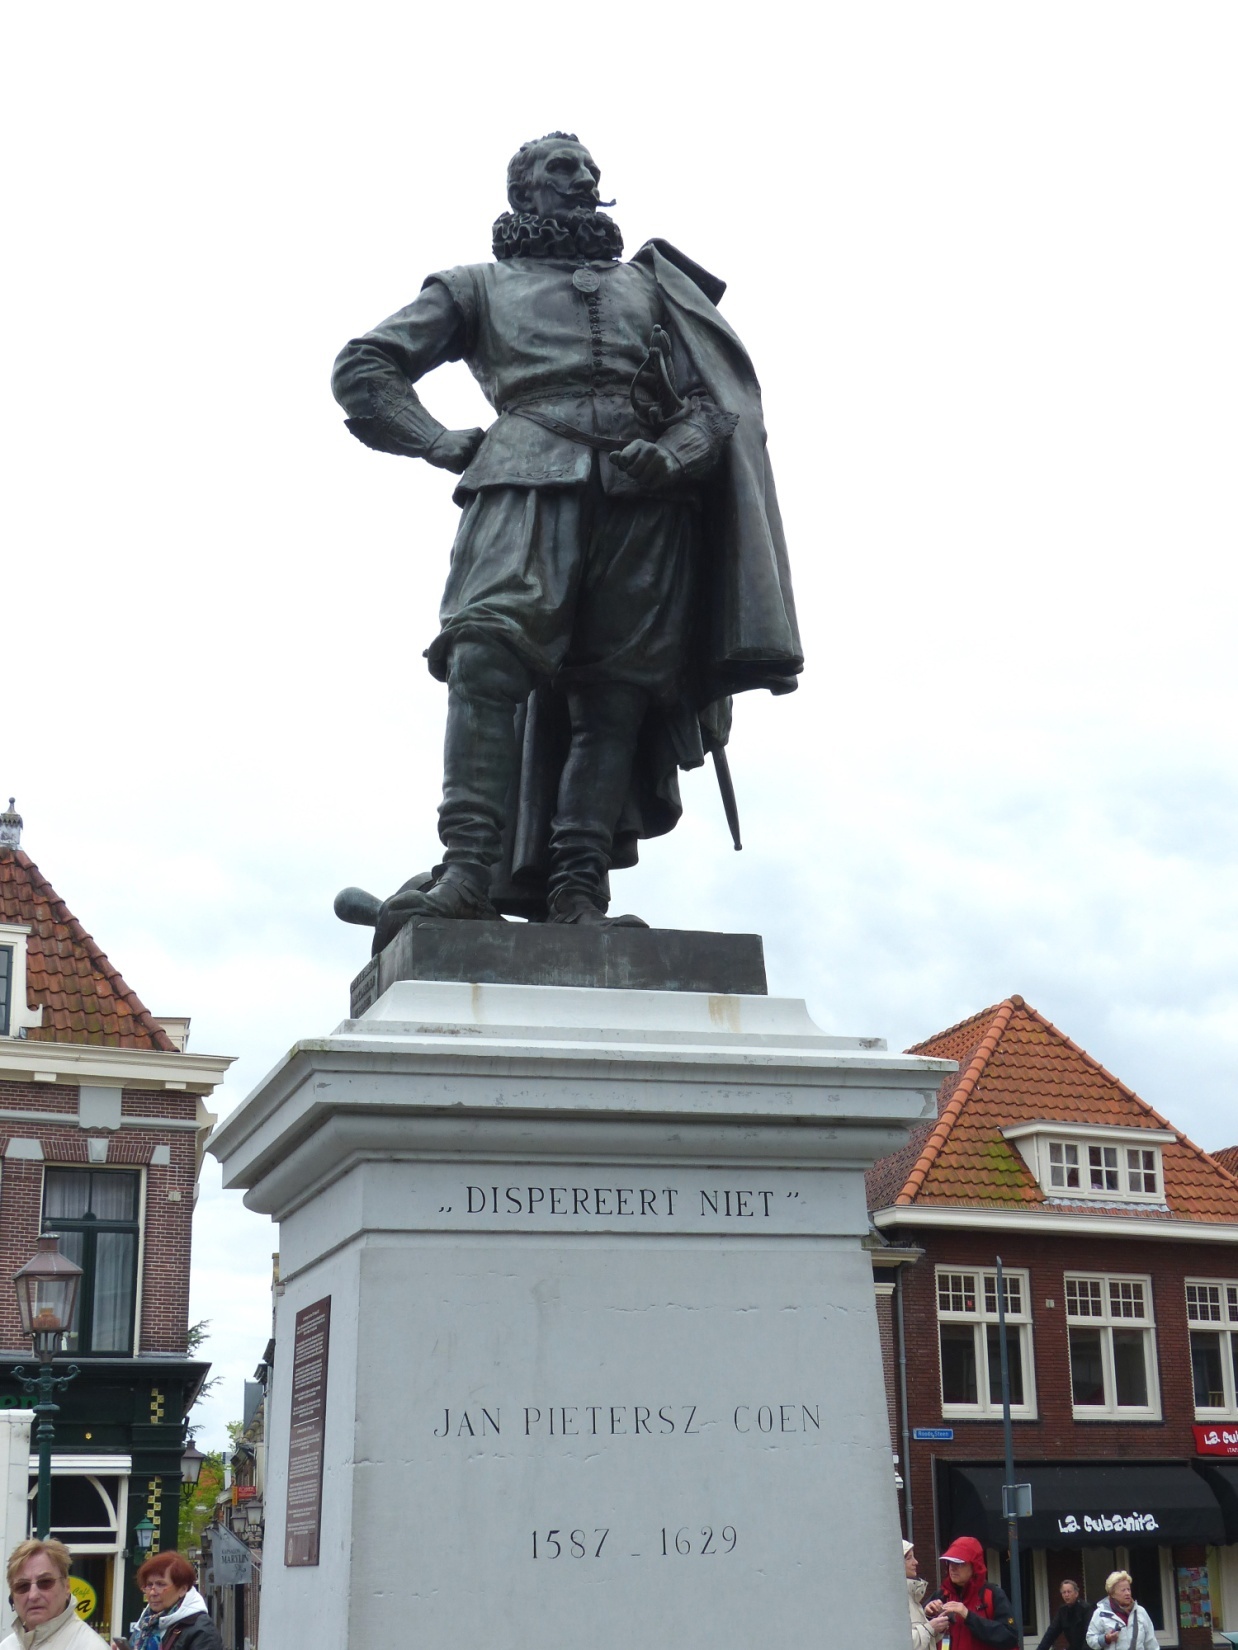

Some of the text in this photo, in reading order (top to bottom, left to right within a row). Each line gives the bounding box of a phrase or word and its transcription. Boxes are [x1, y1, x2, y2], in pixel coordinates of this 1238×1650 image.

[433, 1408, 501, 1437] JAN
[734, 1404, 822, 1433] COEN
[1058, 1511, 1159, 1533] La Cubanita
[531, 1529, 610, 1560] 1587
[660, 1525, 738, 1556] 1629
